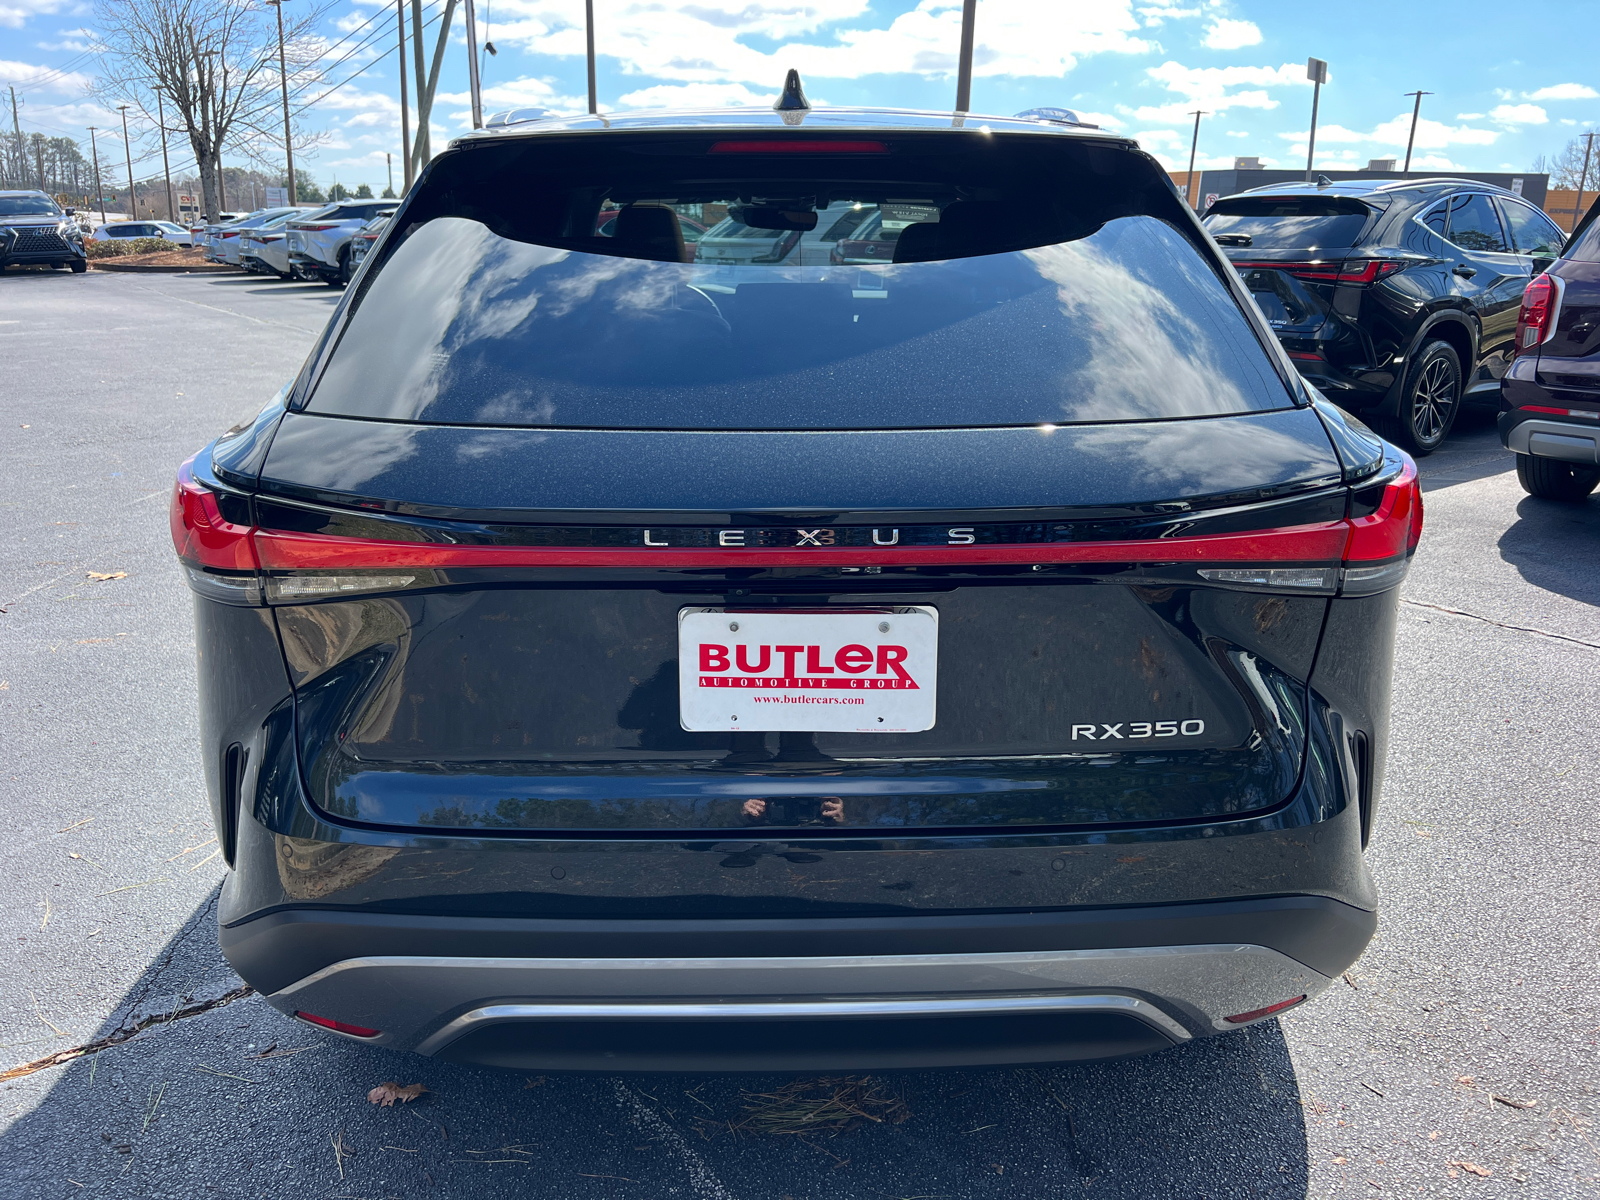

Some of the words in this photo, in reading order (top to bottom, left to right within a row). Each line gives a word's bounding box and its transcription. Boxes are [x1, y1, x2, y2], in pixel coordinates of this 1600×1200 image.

[643, 527, 976, 547] LEXUS
[700, 677, 828, 687] AUTOMOTIVE
[850, 678, 912, 688] GROUP
[753, 694, 865, 705] www.butlercars.com
